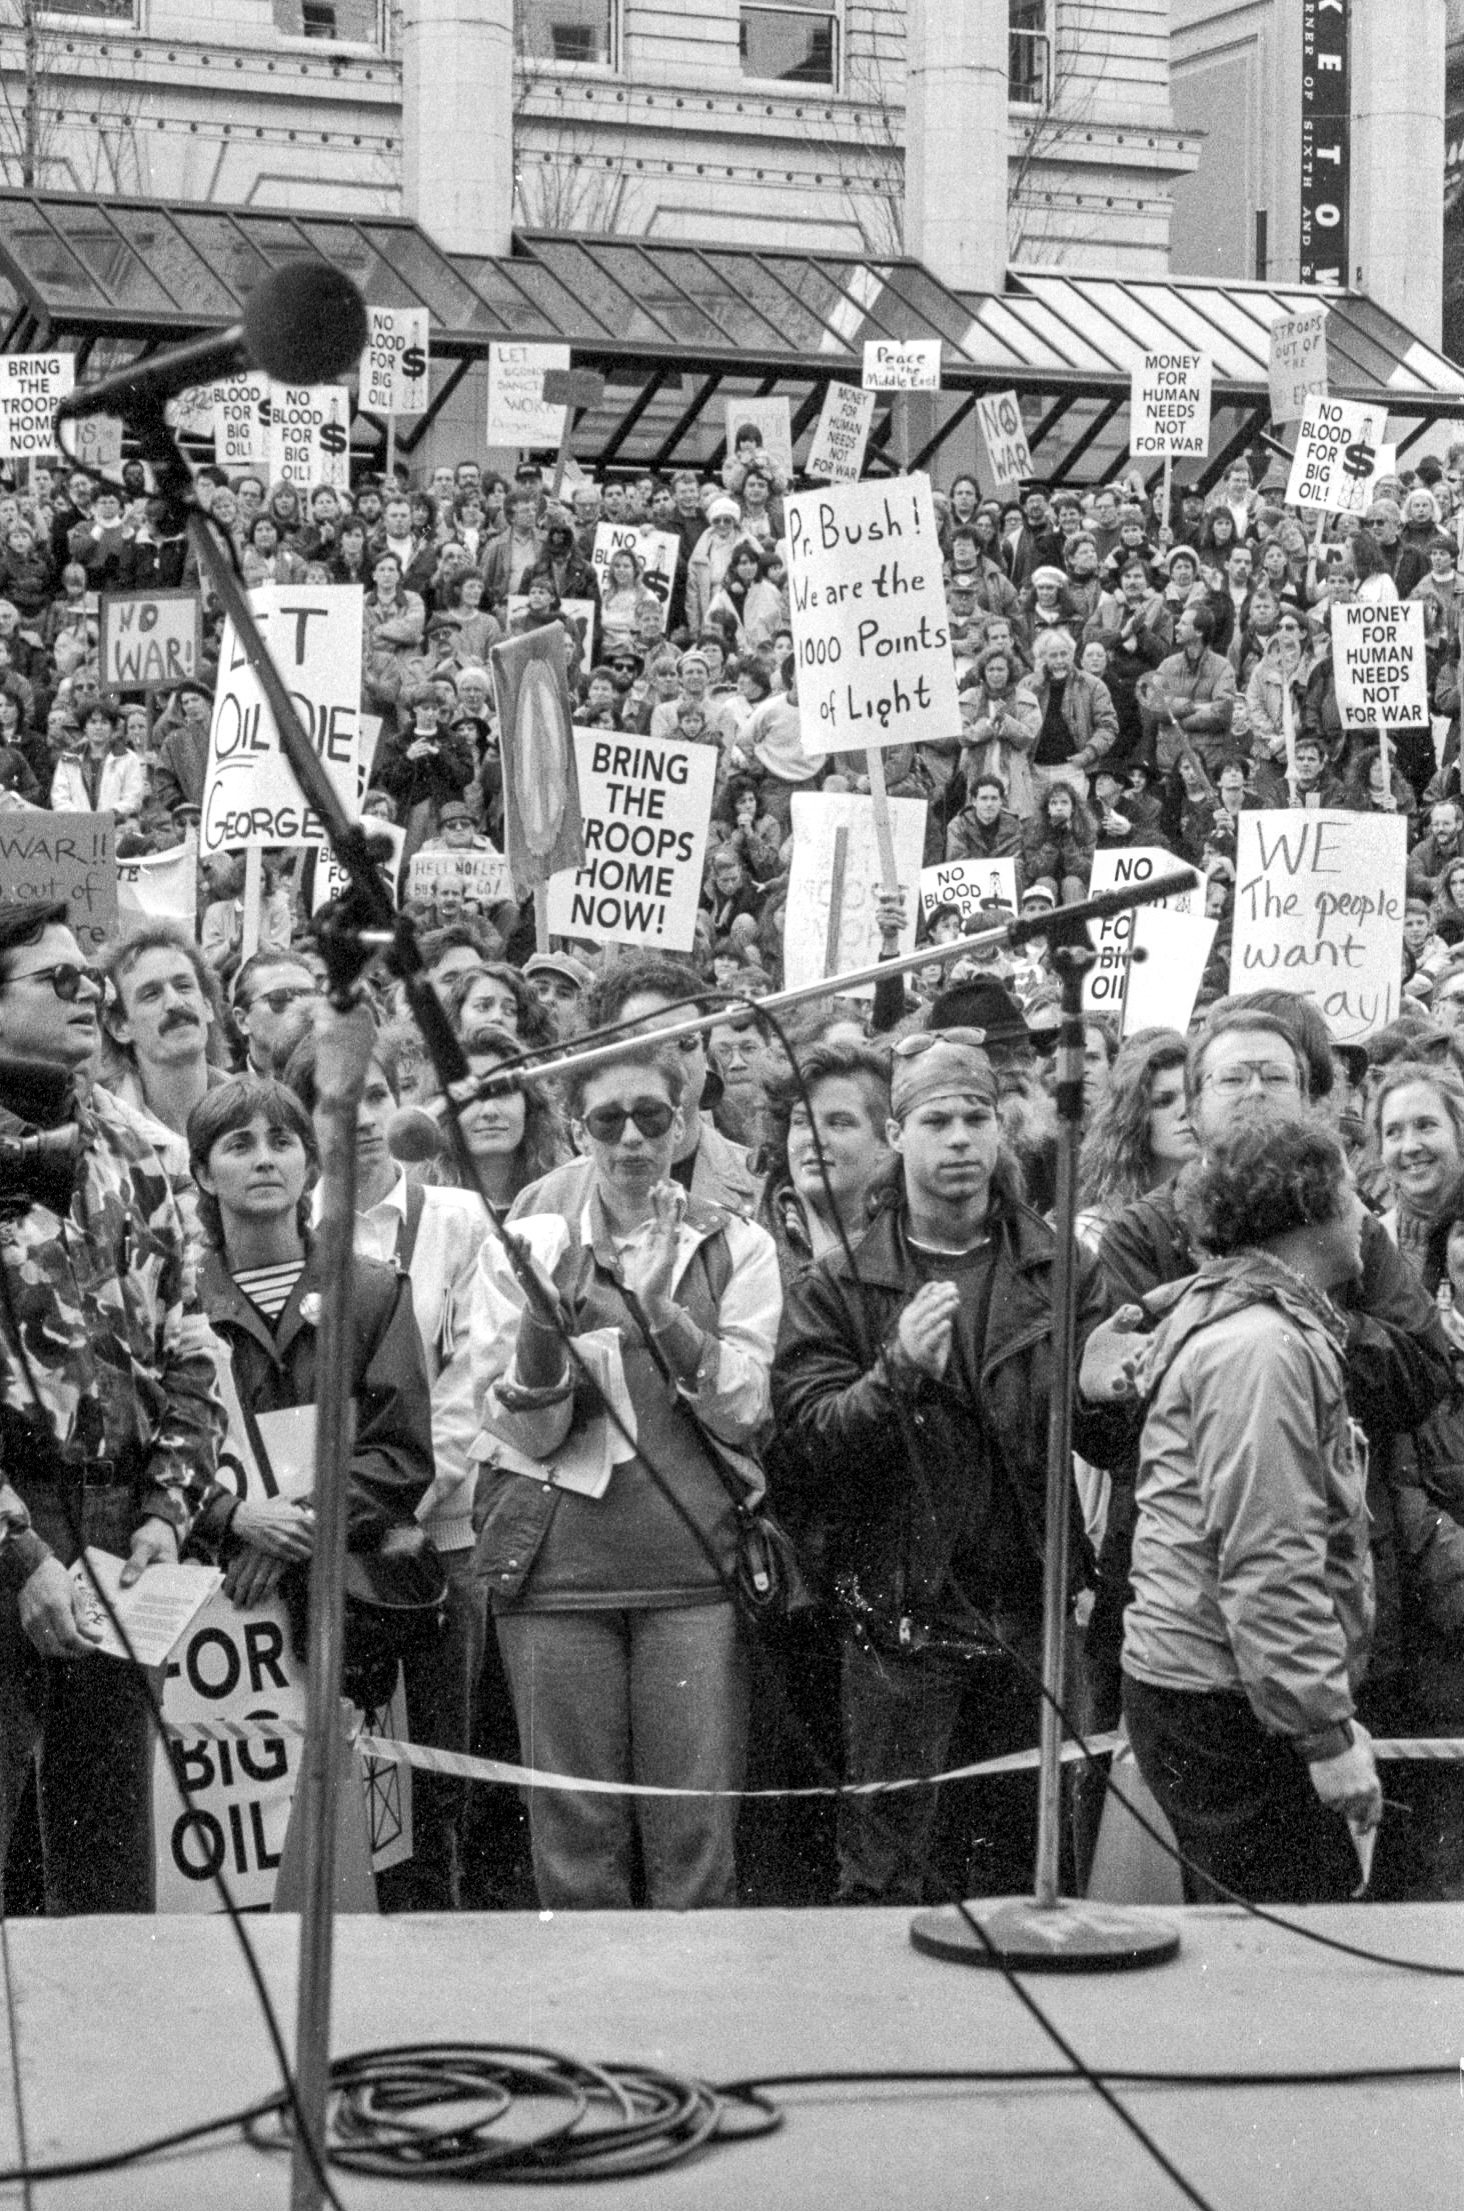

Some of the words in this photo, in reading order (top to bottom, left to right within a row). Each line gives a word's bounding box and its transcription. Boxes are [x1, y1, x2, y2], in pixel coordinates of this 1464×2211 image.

[1304, 76, 1314, 100] OF
[1303, 121, 1313, 187] SIXTH
[1302, 205, 1312, 246] AND
[373, 314, 394, 330] NO
[368, 333, 406, 351] LOOD
[370, 351, 395, 369] FOR
[498, 347, 527, 363] LET
[877, 346, 926, 364] Peace
[1145, 354, 1201, 370] MONEY
[8, 359, 60, 377] BRING
[18, 378, 50, 394] THE
[371, 371, 392, 388] BIG
[1158, 371, 1187, 385] FOR
[213, 387, 261, 403] BLOOD
[286, 391, 310, 406] NO
[1143, 388, 1200, 402] HUMAN
[223, 405, 251, 421] FOR
[272, 408, 323, 425] BLOOD
[841, 404, 857, 417] FOR
[1146, 404, 1196, 419] NEEDS
[1318, 403, 1343, 422] NO
[227, 423, 250, 439] BIG
[282, 427, 312, 443] FOR
[829, 416, 863, 436] HUMAN
[1155, 420, 1186, 435] NOT
[1301, 421, 1353, 444] BLOOD
[828, 432, 857, 450] NEEDS
[1136, 436, 1166, 452] FOR
[1170, 437, 1204, 452] WAR
[284, 446, 309, 462] BIG
[829, 448, 850, 462] NOT
[990, 443, 1034, 480] WAR
[1307, 442, 1338, 463] FOR
[281, 465, 311, 481] OIL!
[813, 457, 834, 474] FOR
[836, 464, 858, 480] WAR
[1305, 463, 1331, 483] BIG
[1298, 482, 1330, 502] OIL!
[611, 531, 637, 550] NO
[595, 549, 647, 571] BLD
[793, 575, 818, 612] We
[825, 580, 863, 605] are
[872, 560, 925, 598] the
[119, 603, 159, 633] NO
[1347, 606, 1411, 625] MONEY
[800, 635, 842, 669] 1000
[858, 616, 948, 657] Points
[1362, 626, 1397, 643] FOR
[115, 637, 192, 681] WAR!
[1346, 646, 1413, 664] HUMAN
[1352, 665, 1410, 684] NEEDS
[820, 689, 837, 727] of
[848, 674, 931, 728] Light
[1363, 686, 1400, 703] NOT
[1345, 707, 1377, 723] FOR
[1382, 705, 1422, 722] WAR
[215, 692, 270, 761] OIL
[591, 742, 689, 785] BRING
[606, 782, 666, 820] THE
[205, 780, 325, 850] GEORGE
[583, 817, 695, 862] ROOPS
[1256, 820, 1353, 875] WE
[328, 865, 350, 884] FO
[574, 858, 674, 898] HOME
[937, 866, 965, 887] NO
[1115, 857, 1153, 882] NO
[17, 877, 66, 899] out
[72, 870, 104, 913] of
[924, 883, 981, 910] BLOOD
[571, 893, 665, 935] NOW!
[1241, 875, 1304, 921] The
[1314, 888, 1403, 940] people
[1100, 915, 1131, 941] FO
[1243, 933, 1367, 969] want
[166, 1620, 291, 1700] OR
[170, 1709, 289, 1793] BIG
[170, 1801, 283, 1882] OIL
